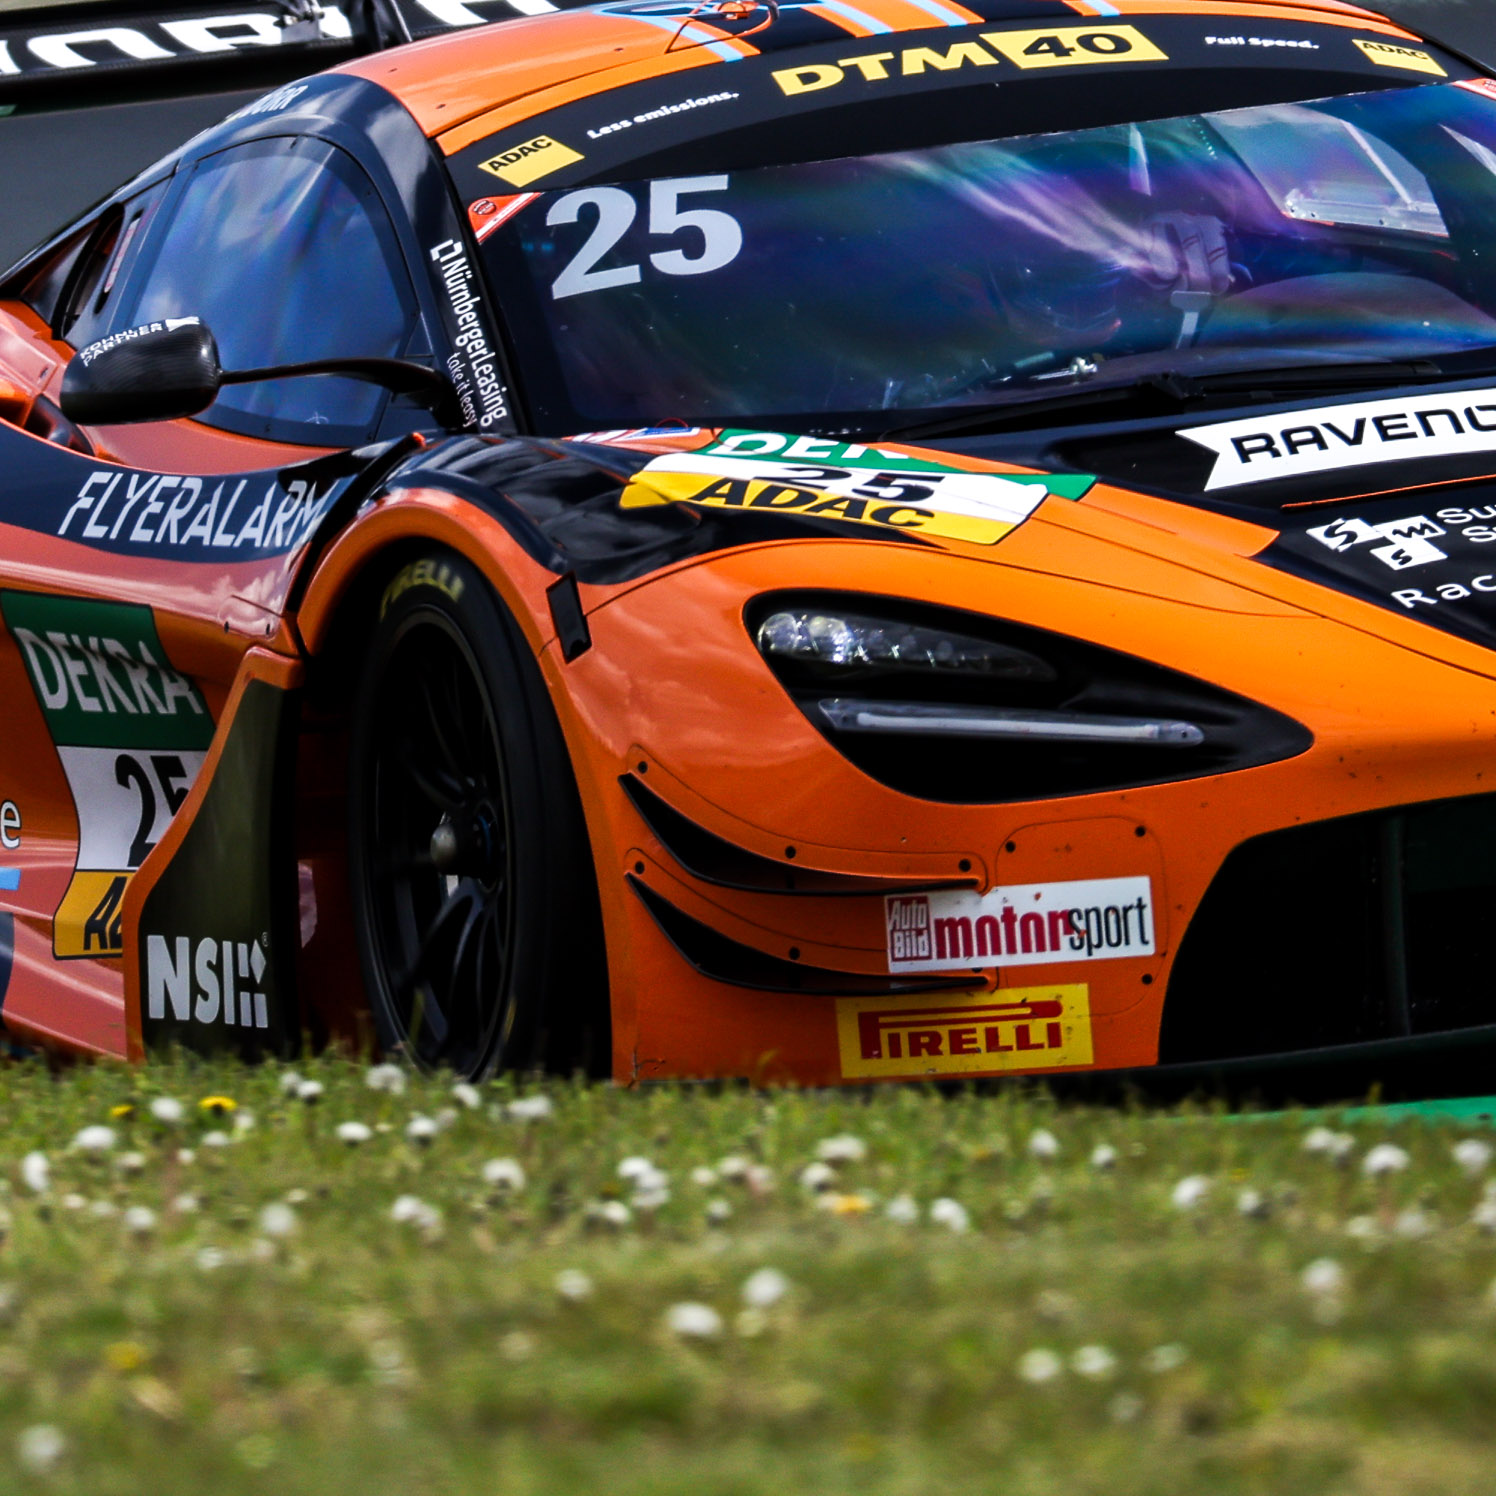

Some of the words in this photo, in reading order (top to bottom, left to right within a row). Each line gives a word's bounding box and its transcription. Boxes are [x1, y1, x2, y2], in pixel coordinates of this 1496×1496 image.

[1204, 35, 1246, 46] Full
[1248, 36, 1320, 49] Speed.
[1361, 40, 1431, 61] ADAC
[771, 41, 999, 95] DTM
[1022, 32, 1134, 58] 40
[586, 119, 633, 141] Less
[487, 135, 554, 174] ADAC
[546, 175, 743, 300] 25
[688, 477, 935, 527] ADAC
[753, 467, 946, 502] 25
[58, 471, 340, 548] FLYERALARM
[14, 627, 203, 715] DEKRA
[888, 900, 927, 930] Auto
[893, 929, 930, 958] Bild
[858, 1000, 1064, 1060] PIRELLI
